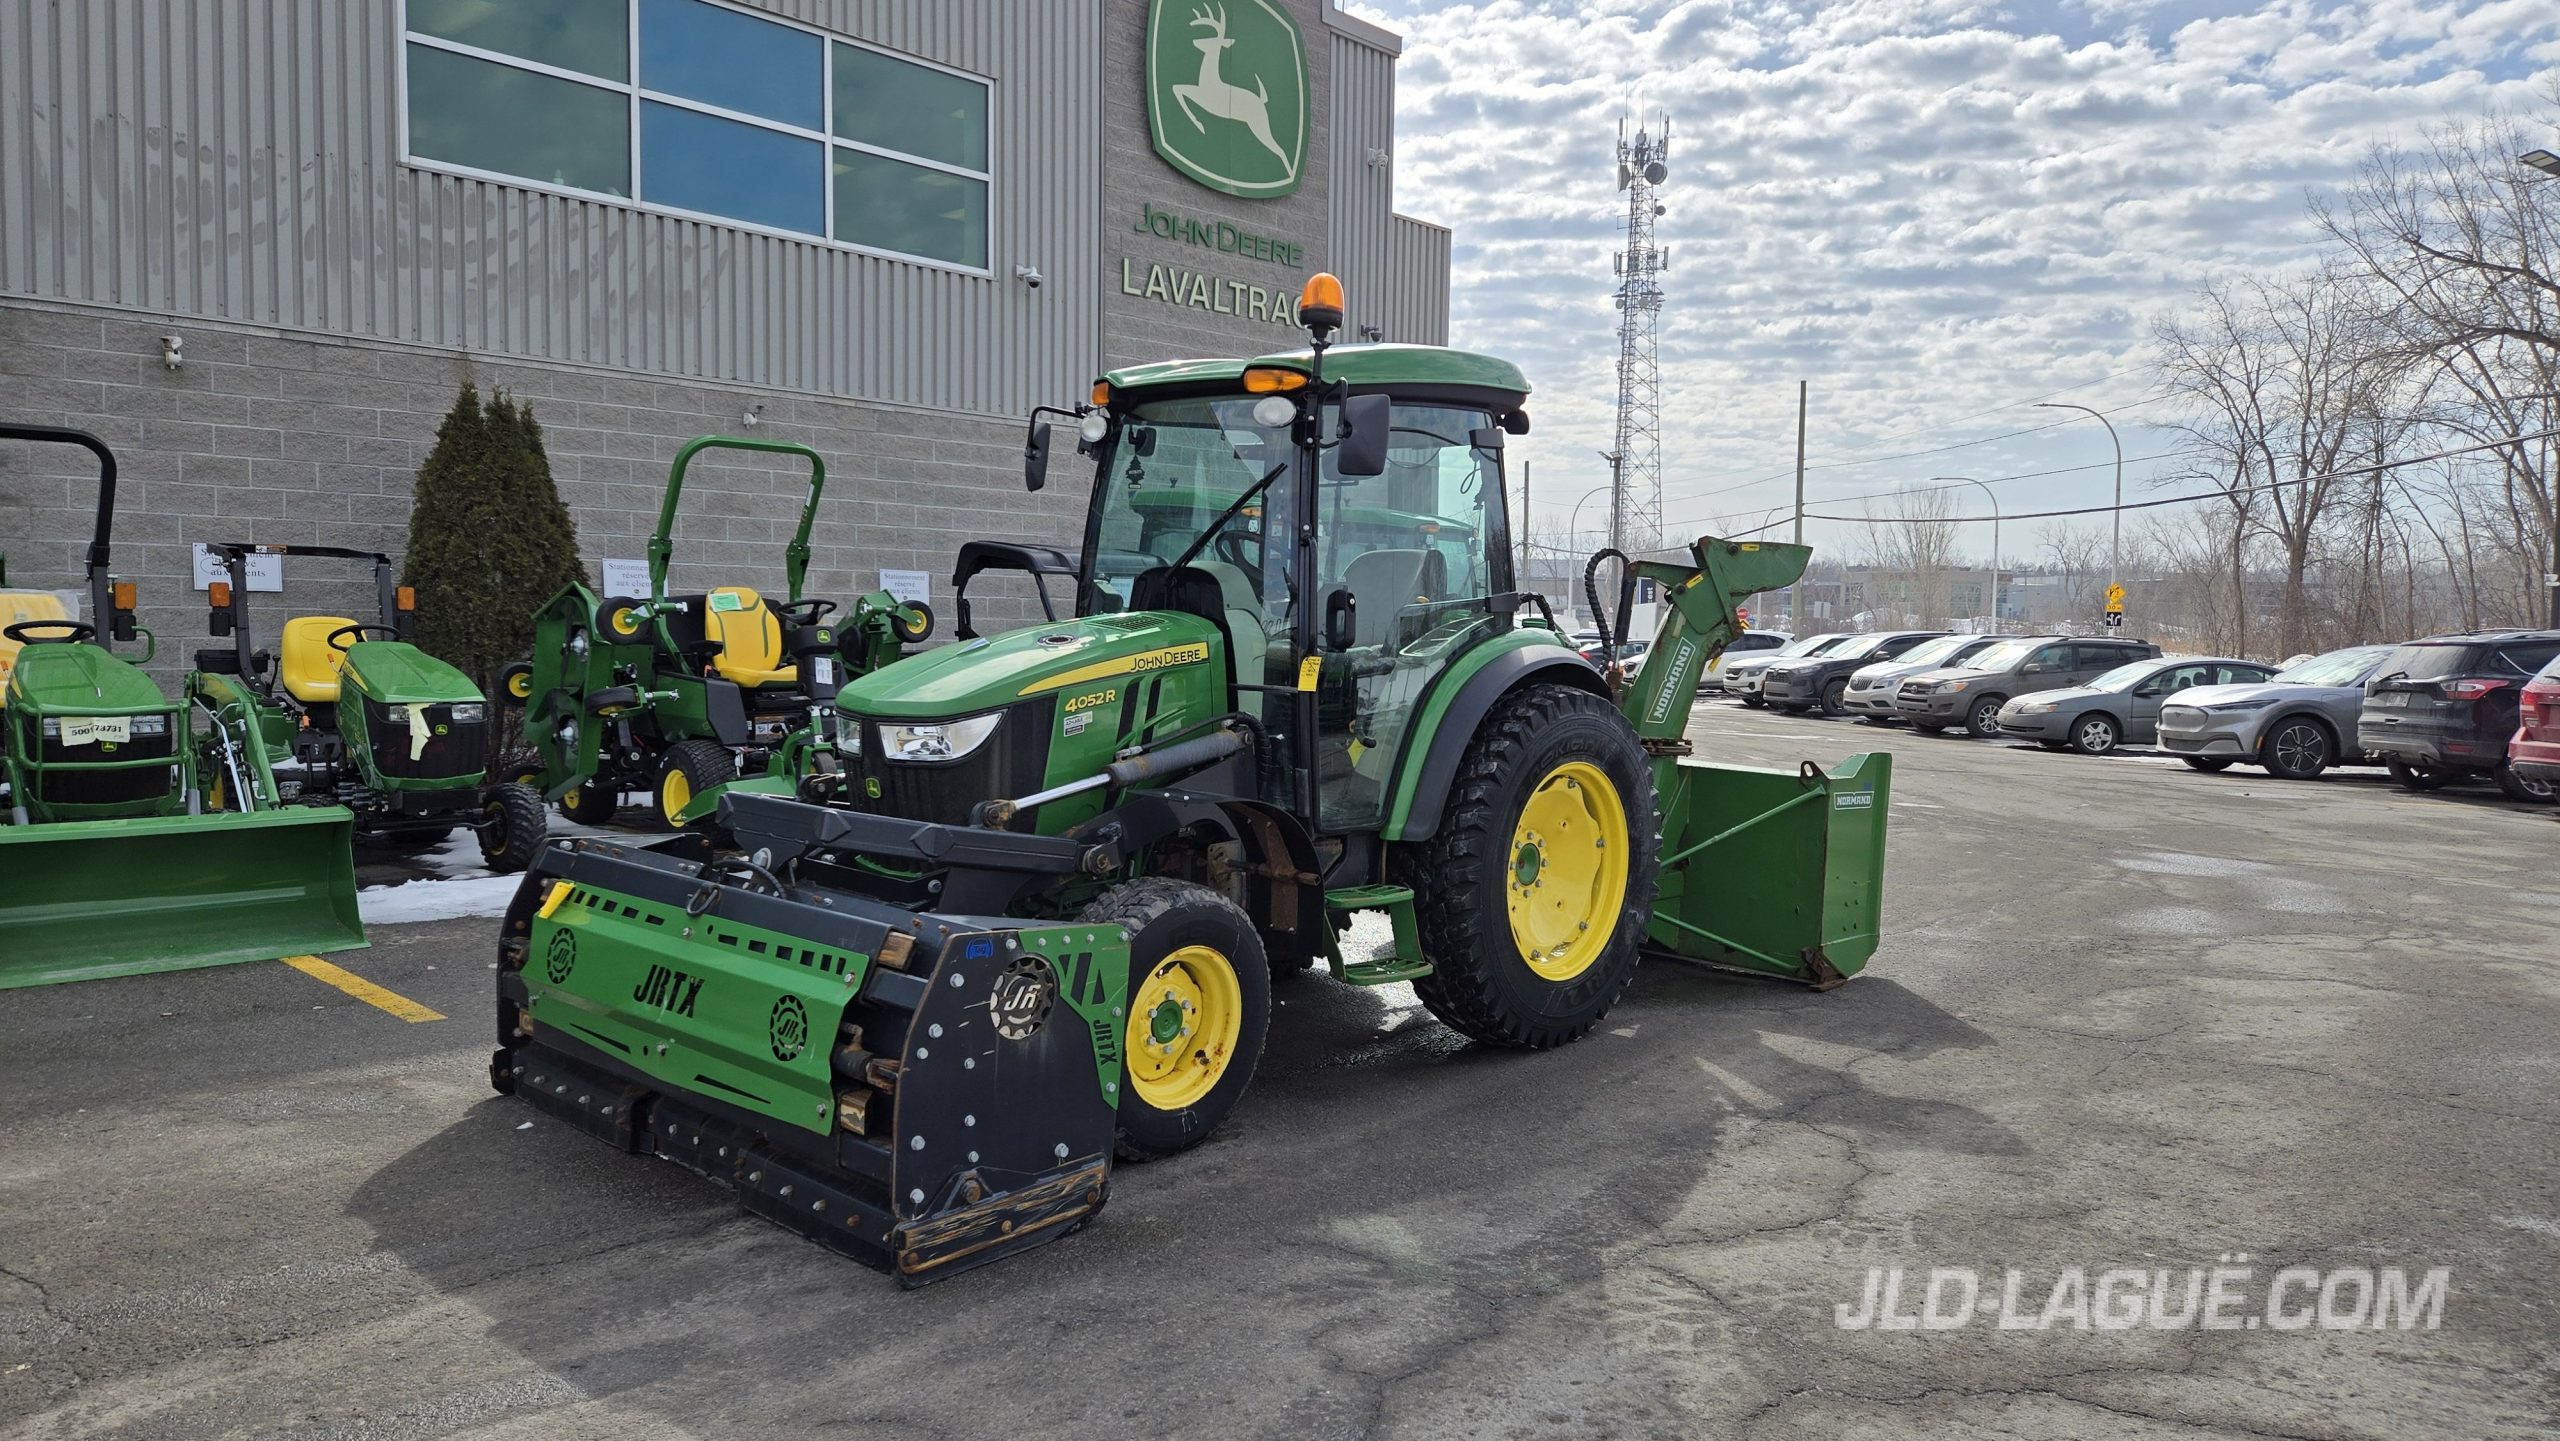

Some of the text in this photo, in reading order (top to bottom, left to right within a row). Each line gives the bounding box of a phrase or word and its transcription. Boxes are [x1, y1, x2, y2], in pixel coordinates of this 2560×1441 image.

[1135, 203, 1305, 269] JOHN DEERE
[1131, 649, 1200, 671] JOHN DEERE
[1654, 645, 1691, 718] NORMAND
[1836, 795, 1871, 806] NORMAND
[633, 964, 705, 1018] JRTX
[778, 1018, 799, 1040] JR
[1092, 1019, 1118, 1066] JRTX
